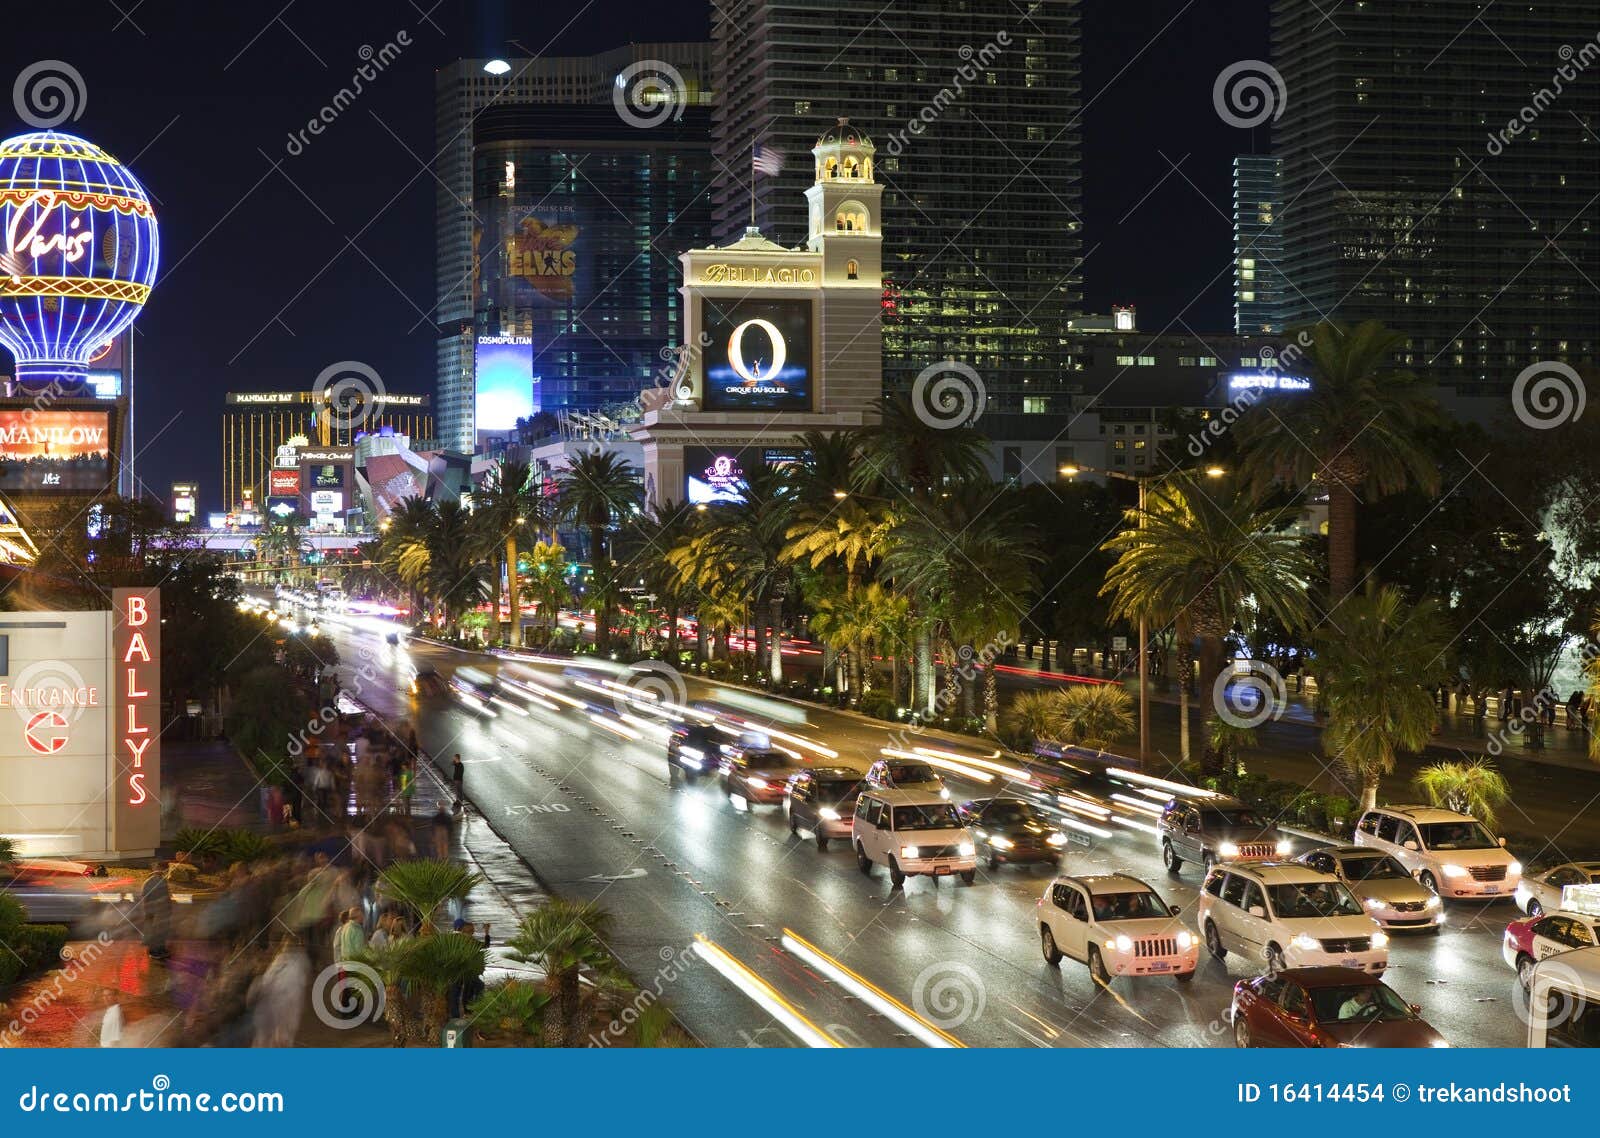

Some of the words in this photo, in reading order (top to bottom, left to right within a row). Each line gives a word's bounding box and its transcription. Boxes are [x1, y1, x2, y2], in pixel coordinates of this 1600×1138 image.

[8, 189, 94, 263] Paris
[510, 250, 576, 276] ELVIS
[701, 263, 816, 283] BELLAGIO
[478, 336, 532, 345] COSMOPOLITAN
[726, 386, 751, 394] CIRQUE
[237, 394, 277, 402] MANDALAY
[279, 394, 292, 402] BAY
[372, 395, 408, 403] MANDALAY
[409, 396, 422, 404] BAY
[0, 427, 104, 445] MANILOW
[279, 447, 297, 456] NEW
[279, 457, 297, 466] NEW
[0, 683, 98, 706] ENTRANCE
[124, 597, 150, 804] BALLYS
[503, 803, 571, 816] ONLY
